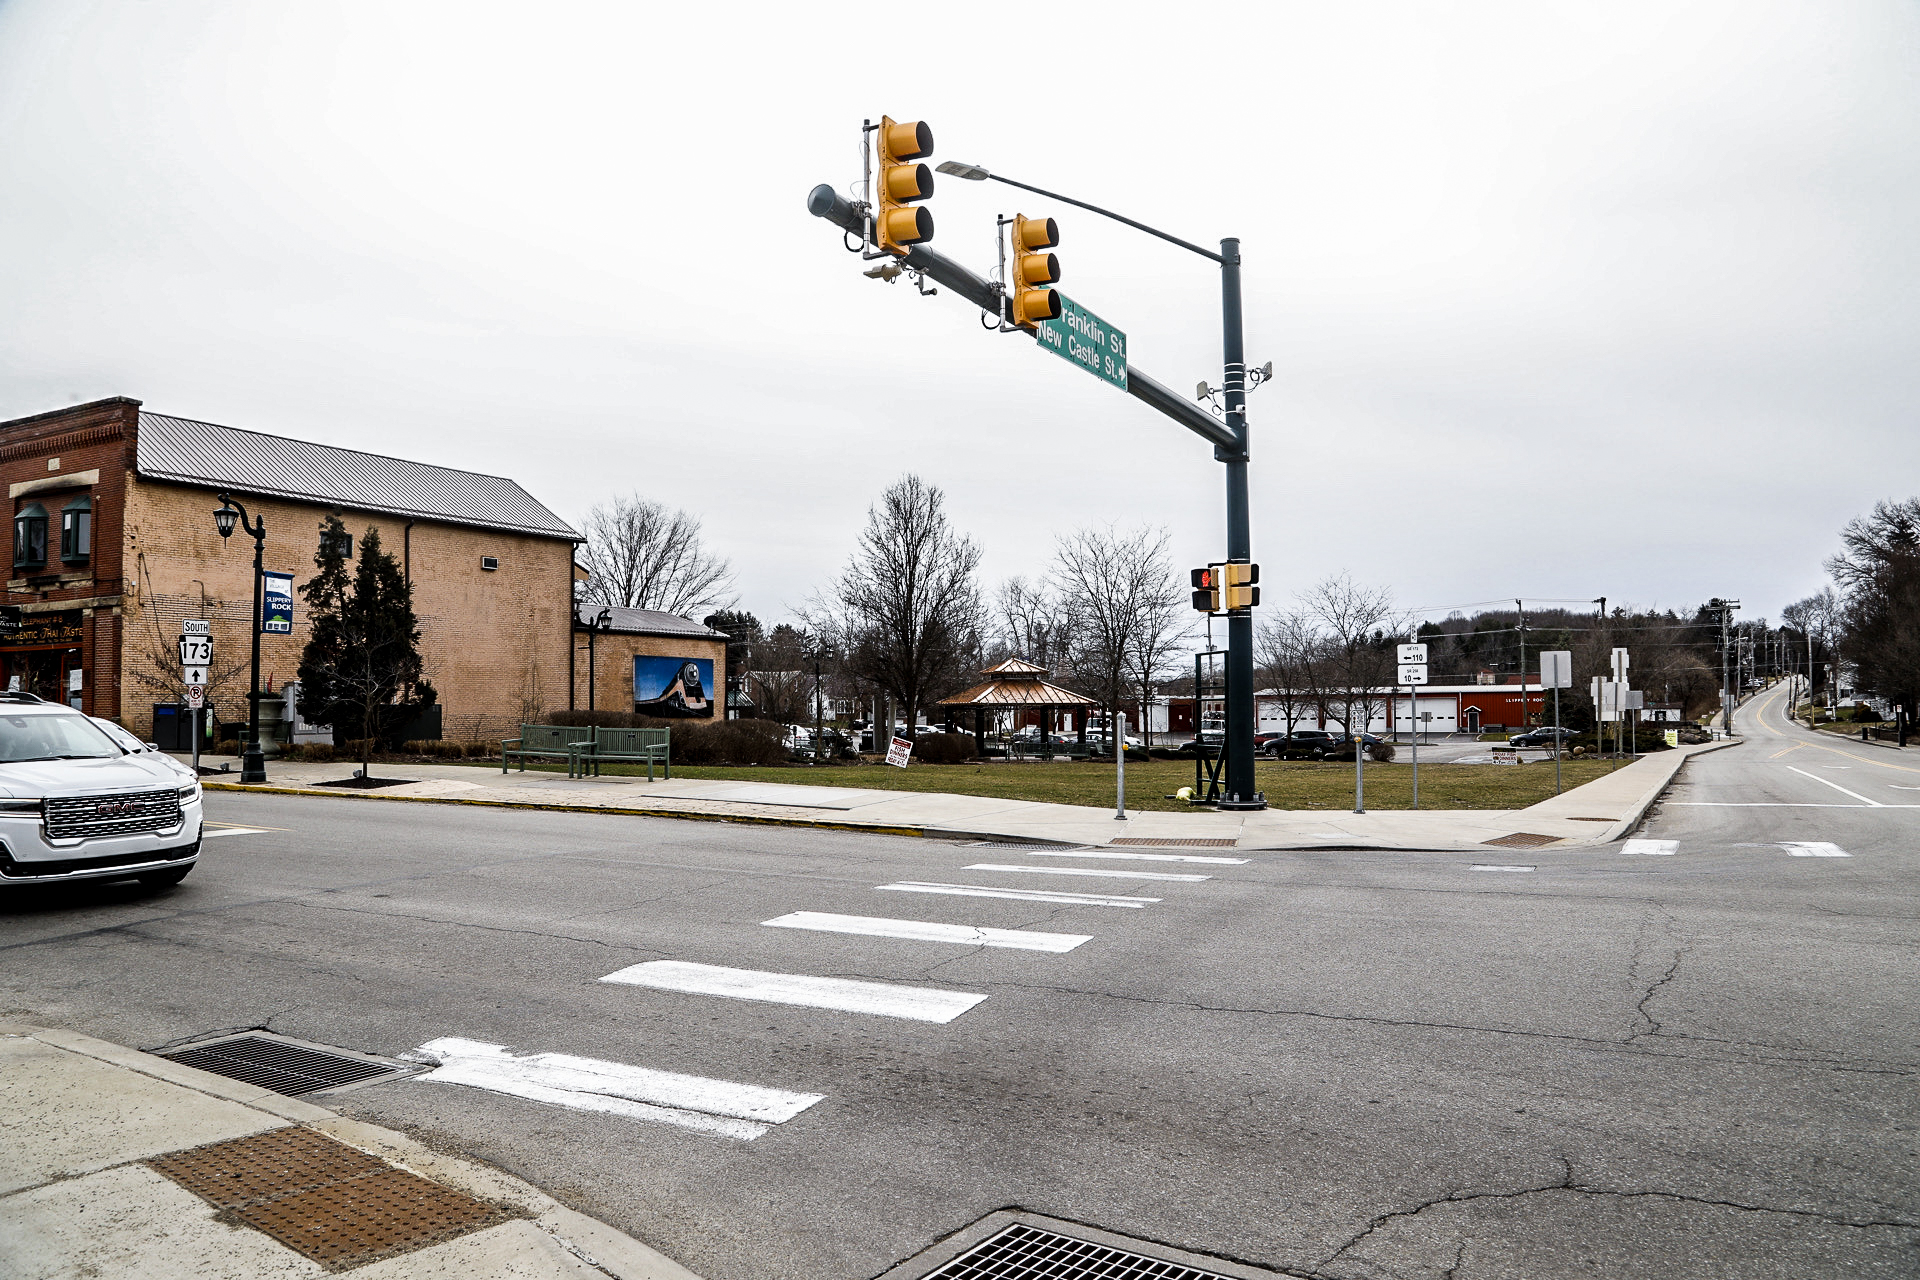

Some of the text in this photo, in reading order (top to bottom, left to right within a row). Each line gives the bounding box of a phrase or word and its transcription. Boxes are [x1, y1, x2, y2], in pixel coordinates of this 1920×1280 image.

[1060, 300, 1126, 359] ranklin St.
[1038, 320, 1118, 380] New Castle St.
[266, 596, 291, 604] SLIPPERY
[271, 603, 292, 611] ROCK
[22, 616, 52, 626] ELEPHANT
[184, 621, 208, 632] SOUTH
[40, 627, 59, 639] THAI
[61, 626, 84, 638] TASTE
[182, 642, 210, 659] 173
[1404, 674, 1412, 682] 10
[98, 802, 145, 814] GMC
